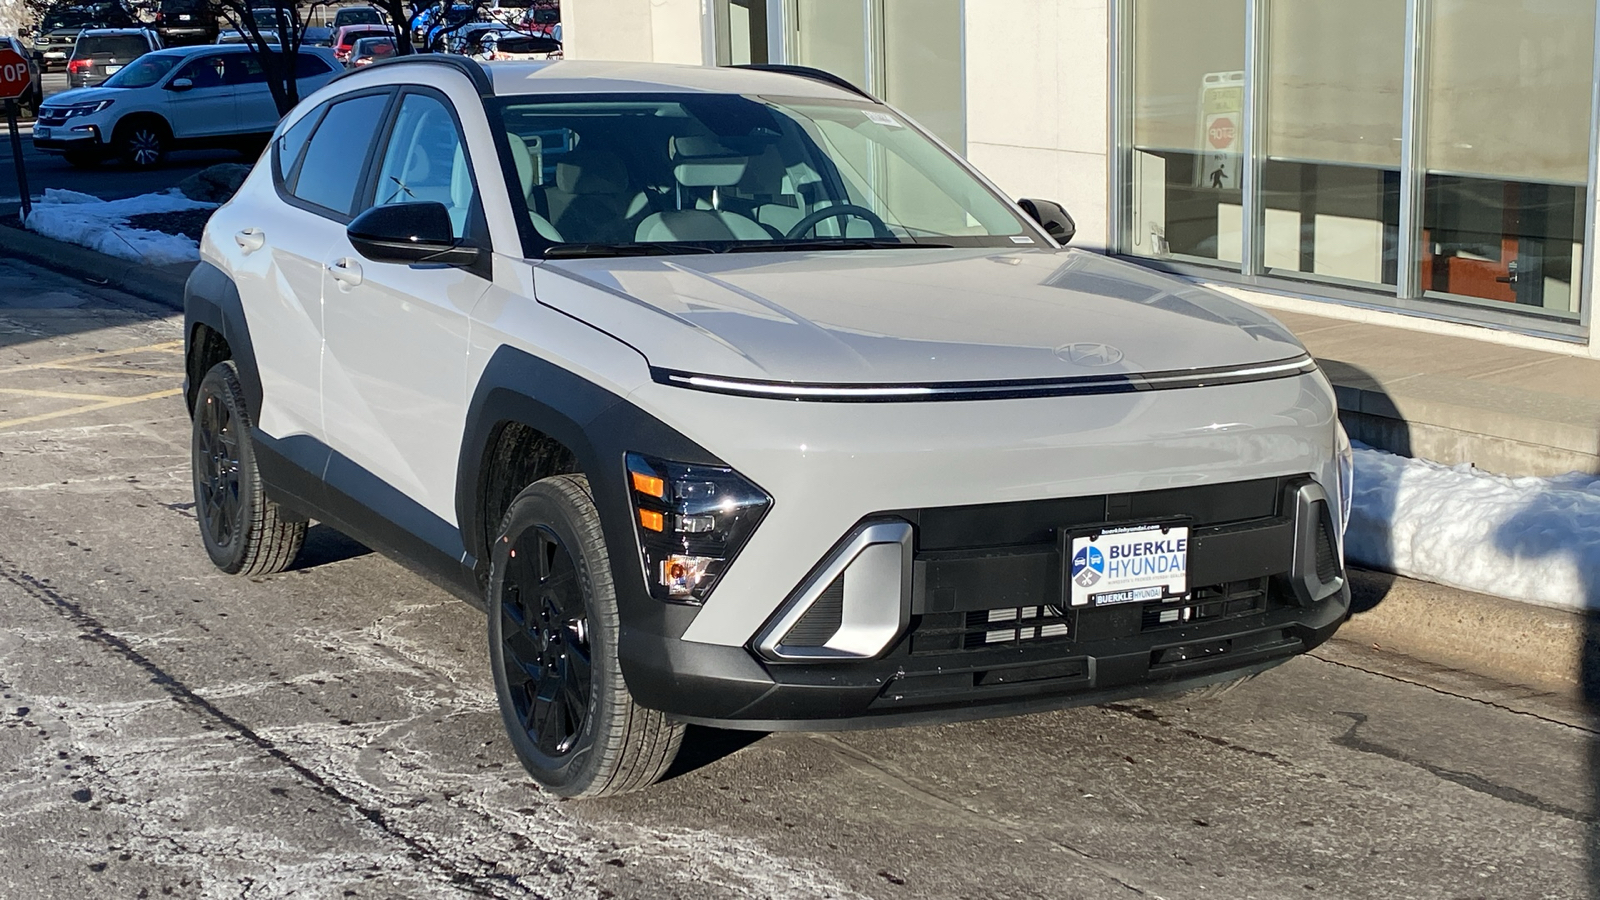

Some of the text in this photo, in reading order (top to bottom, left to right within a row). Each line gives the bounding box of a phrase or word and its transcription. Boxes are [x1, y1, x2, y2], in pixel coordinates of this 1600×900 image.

[0, 63, 26, 83] OP
[1110, 539, 1187, 559] BUERKLE
[1108, 554, 1186, 579] HYUNDAI
[1097, 588, 1160, 604] BUERKLE HYUNDAI
